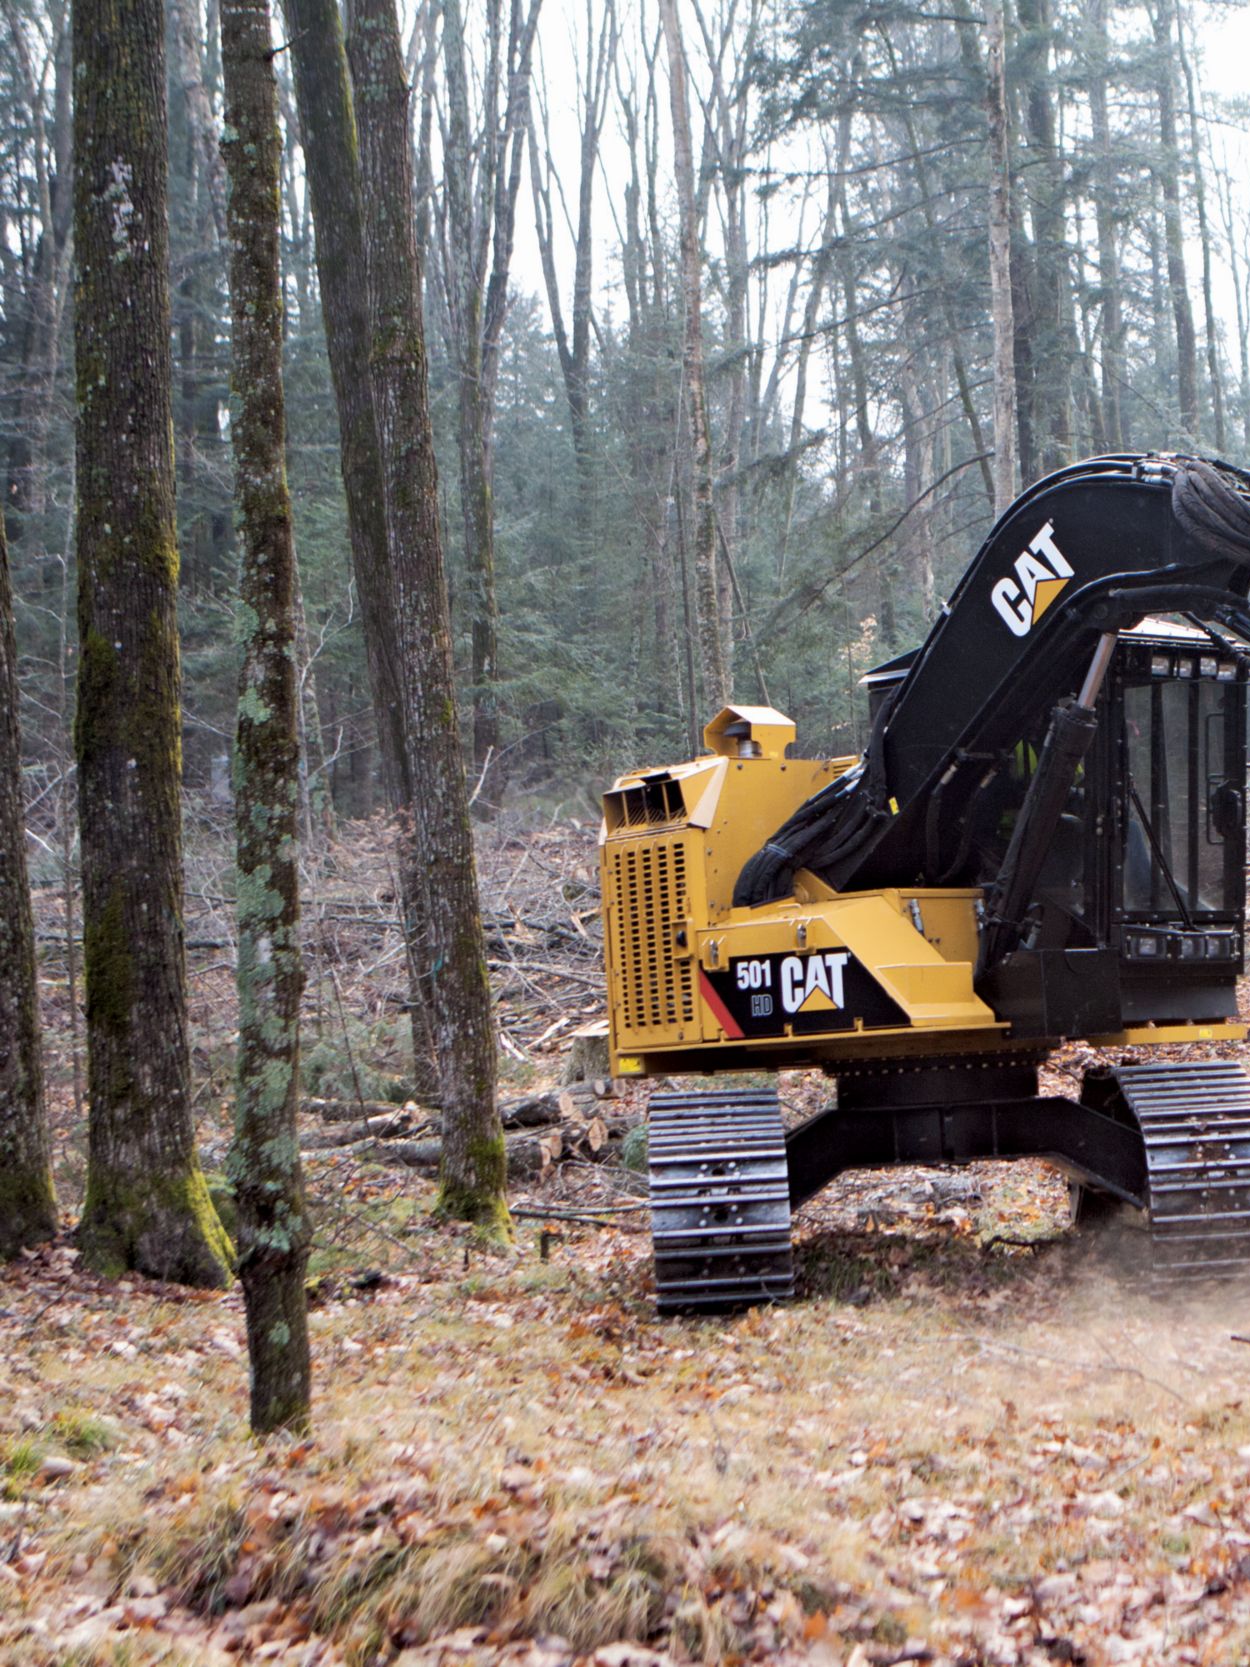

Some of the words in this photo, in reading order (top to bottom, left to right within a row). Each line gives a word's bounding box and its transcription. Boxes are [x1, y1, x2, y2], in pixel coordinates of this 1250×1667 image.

[991, 521, 1075, 637] CAT
[736, 959, 772, 990] 501
[780, 952, 848, 1014] CAT
[751, 993, 774, 1017] HD
